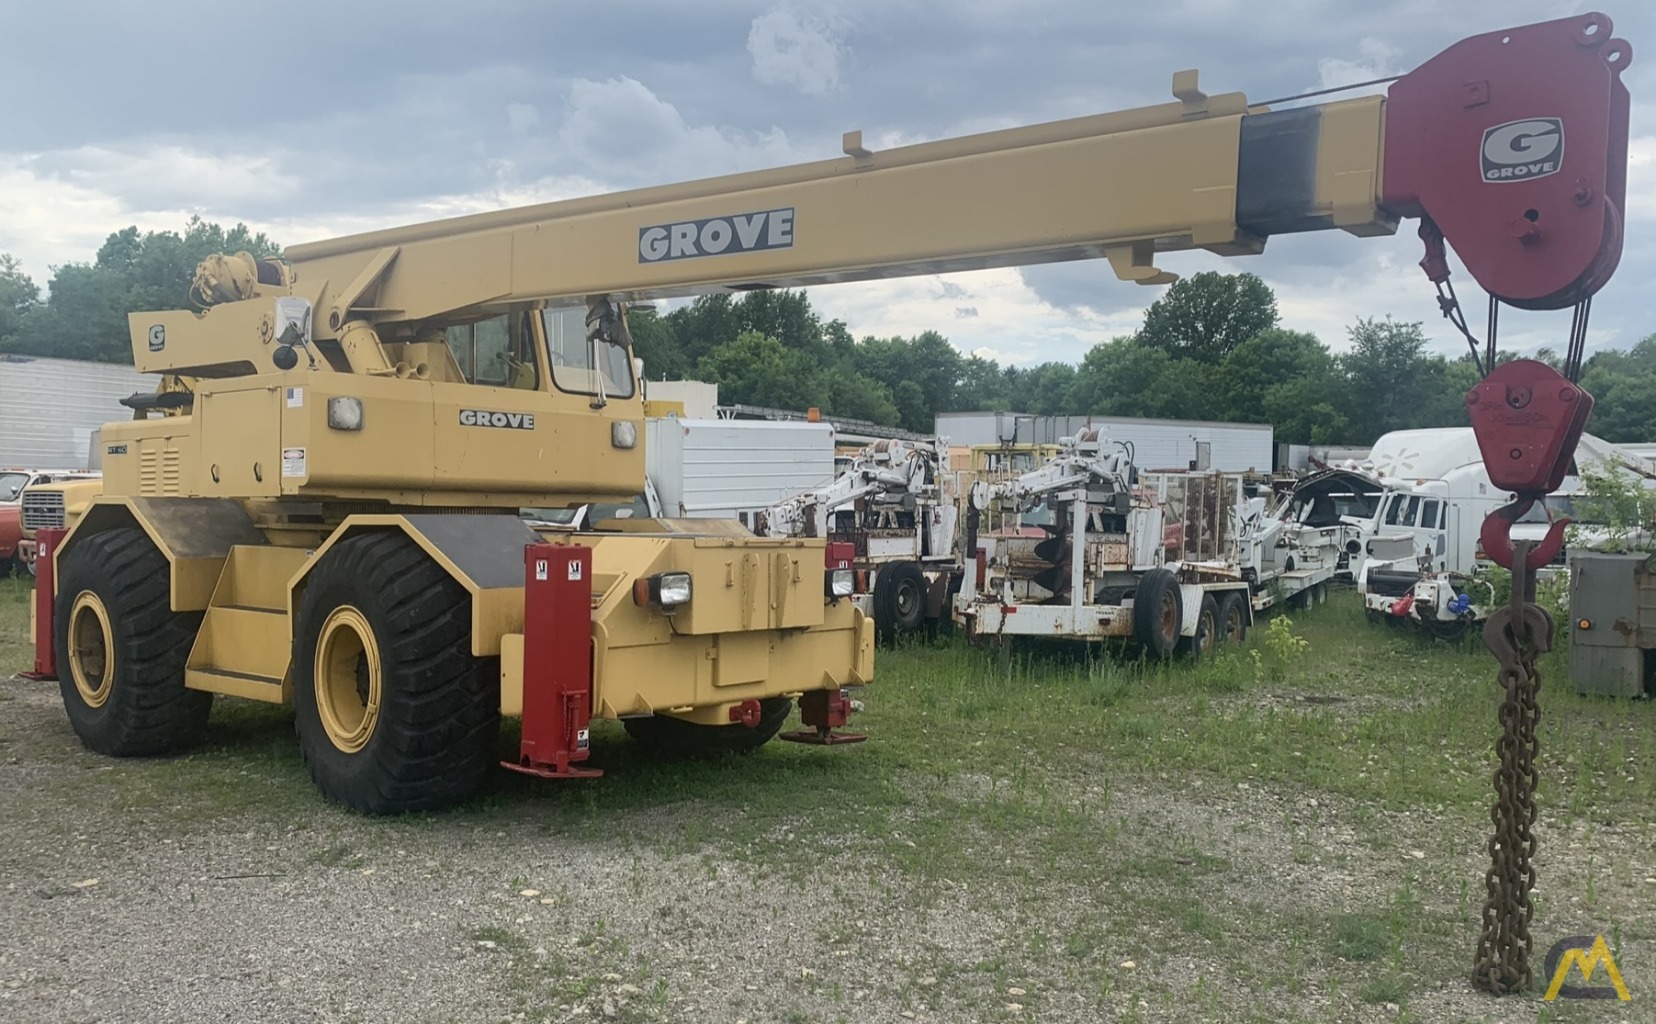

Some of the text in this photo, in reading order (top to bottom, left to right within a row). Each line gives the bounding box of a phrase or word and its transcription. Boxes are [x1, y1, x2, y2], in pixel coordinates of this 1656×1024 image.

[1484, 121, 1560, 164] G
[1486, 162, 1554, 179] GROVE
[639, 209, 794, 261] GROVE
[150, 325, 164, 344] G
[460, 410, 534, 429] GROVE
